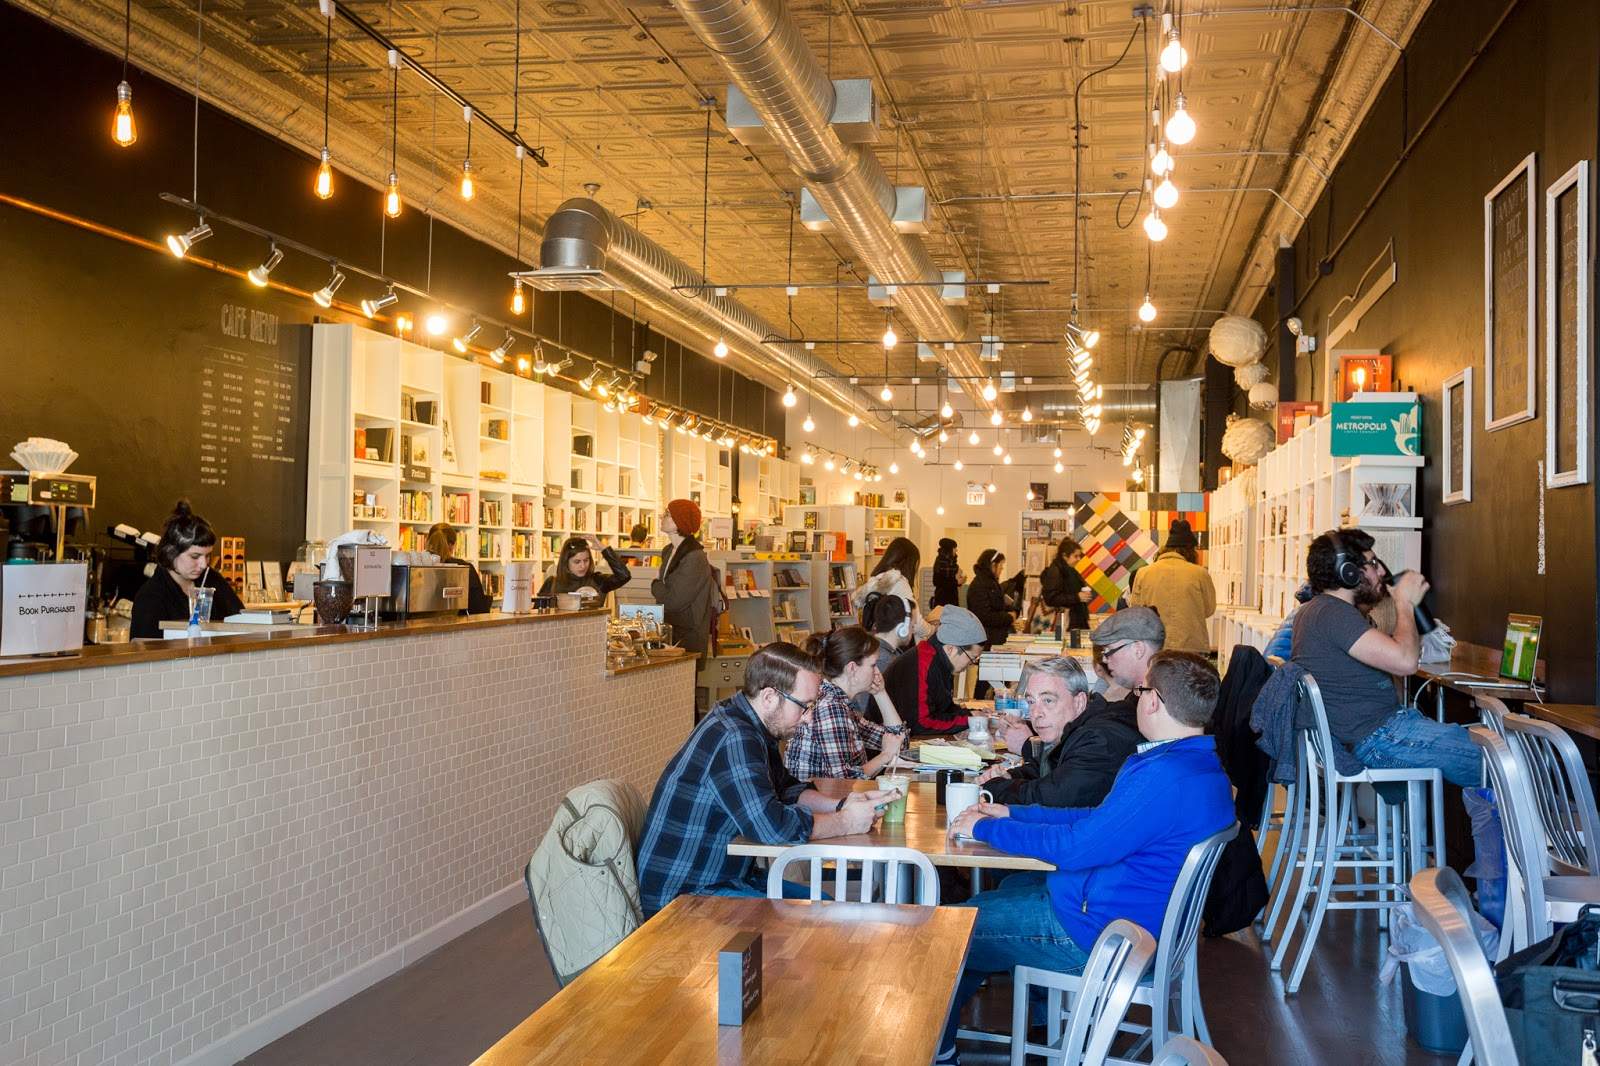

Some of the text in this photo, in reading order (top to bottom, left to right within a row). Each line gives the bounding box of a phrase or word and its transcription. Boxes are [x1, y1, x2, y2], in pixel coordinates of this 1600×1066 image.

[221, 304, 278, 345] CAFE MENU
[1336, 422, 1387, 431] METROPOLIS
[19, 606, 39, 615] BOOK
